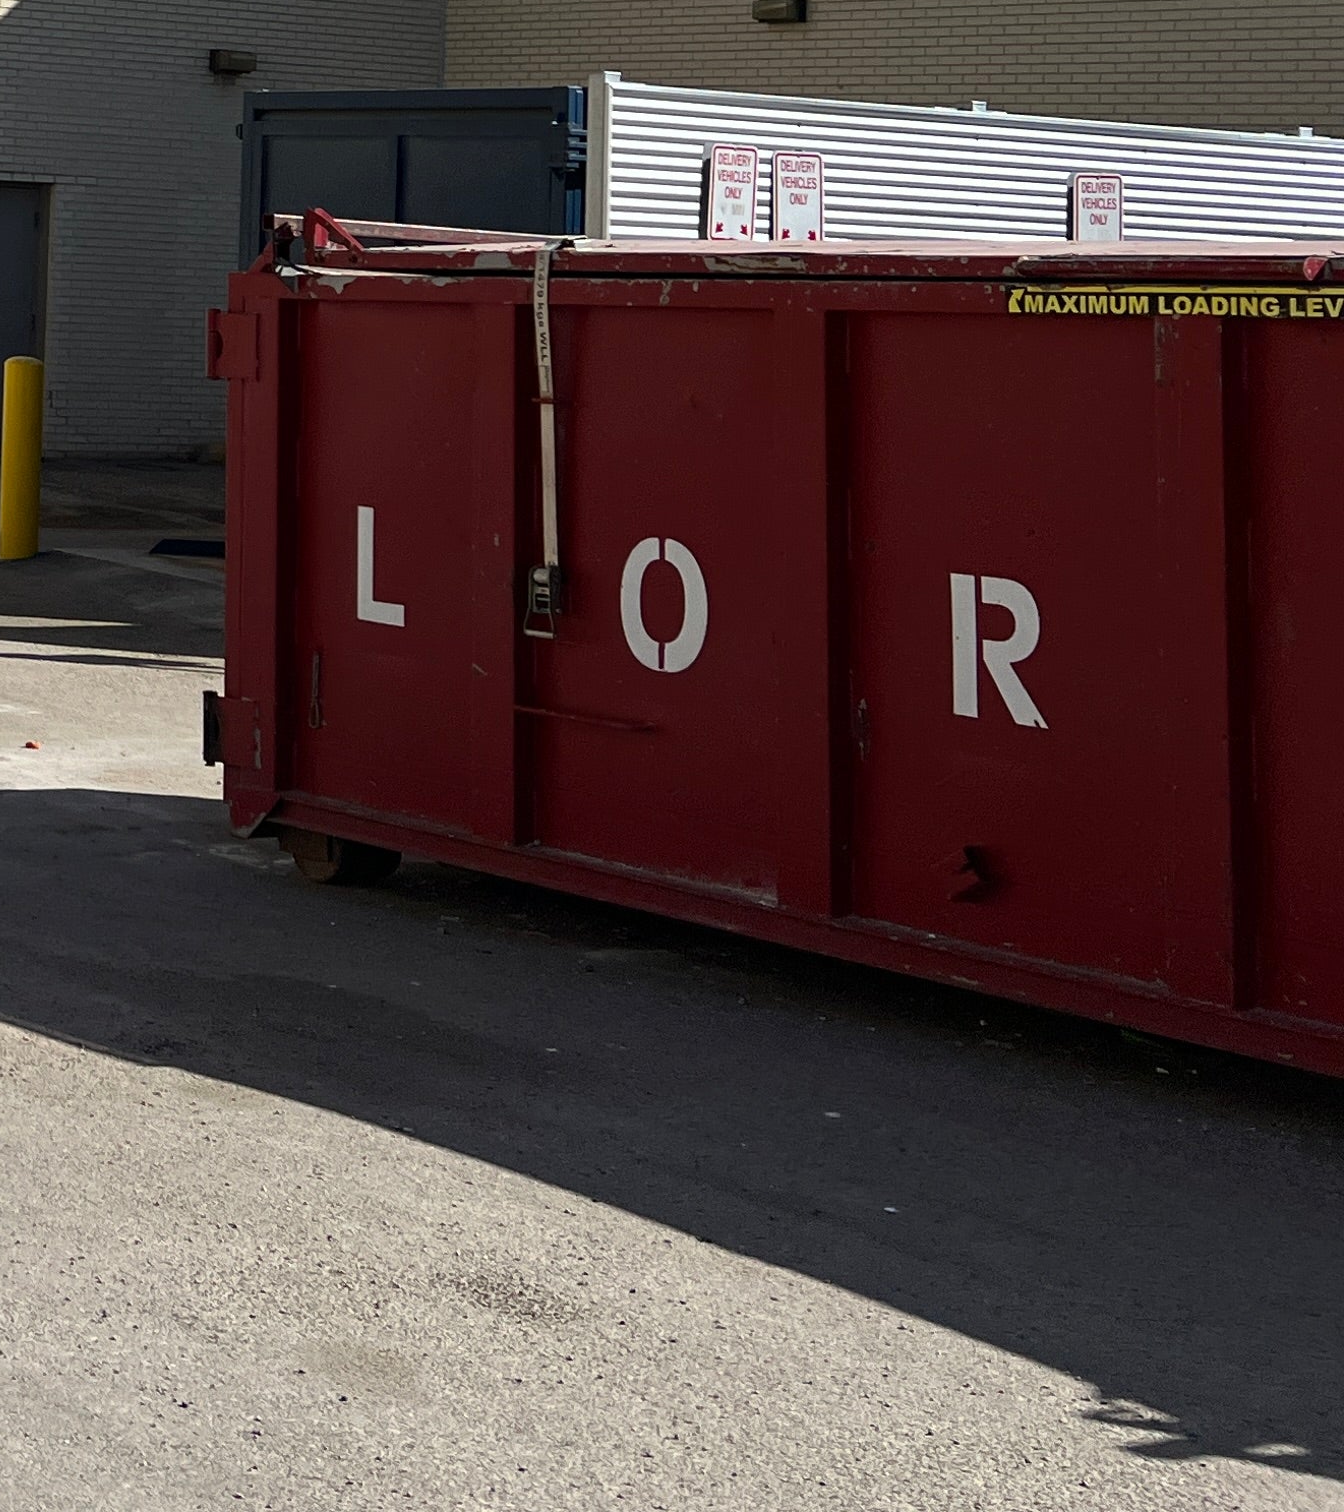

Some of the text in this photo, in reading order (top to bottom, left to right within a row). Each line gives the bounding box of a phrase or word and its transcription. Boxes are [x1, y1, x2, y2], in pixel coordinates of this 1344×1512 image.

[718, 153, 751, 166] DELIVERY
[780, 160, 816, 173] DELIVERY
[717, 170, 751, 183] VEHICLES
[781, 176, 817, 189] VEHICLES
[725, 186, 743, 199] ONLY
[1081, 182, 1117, 193] DELIVERY
[789, 193, 809, 206] ONLY
[1081, 198, 1117, 210] VEHICLES
[1089, 213, 1108, 225] ONLY
[1024, 294, 1344, 317] MAXIMUM LOADING LEV
